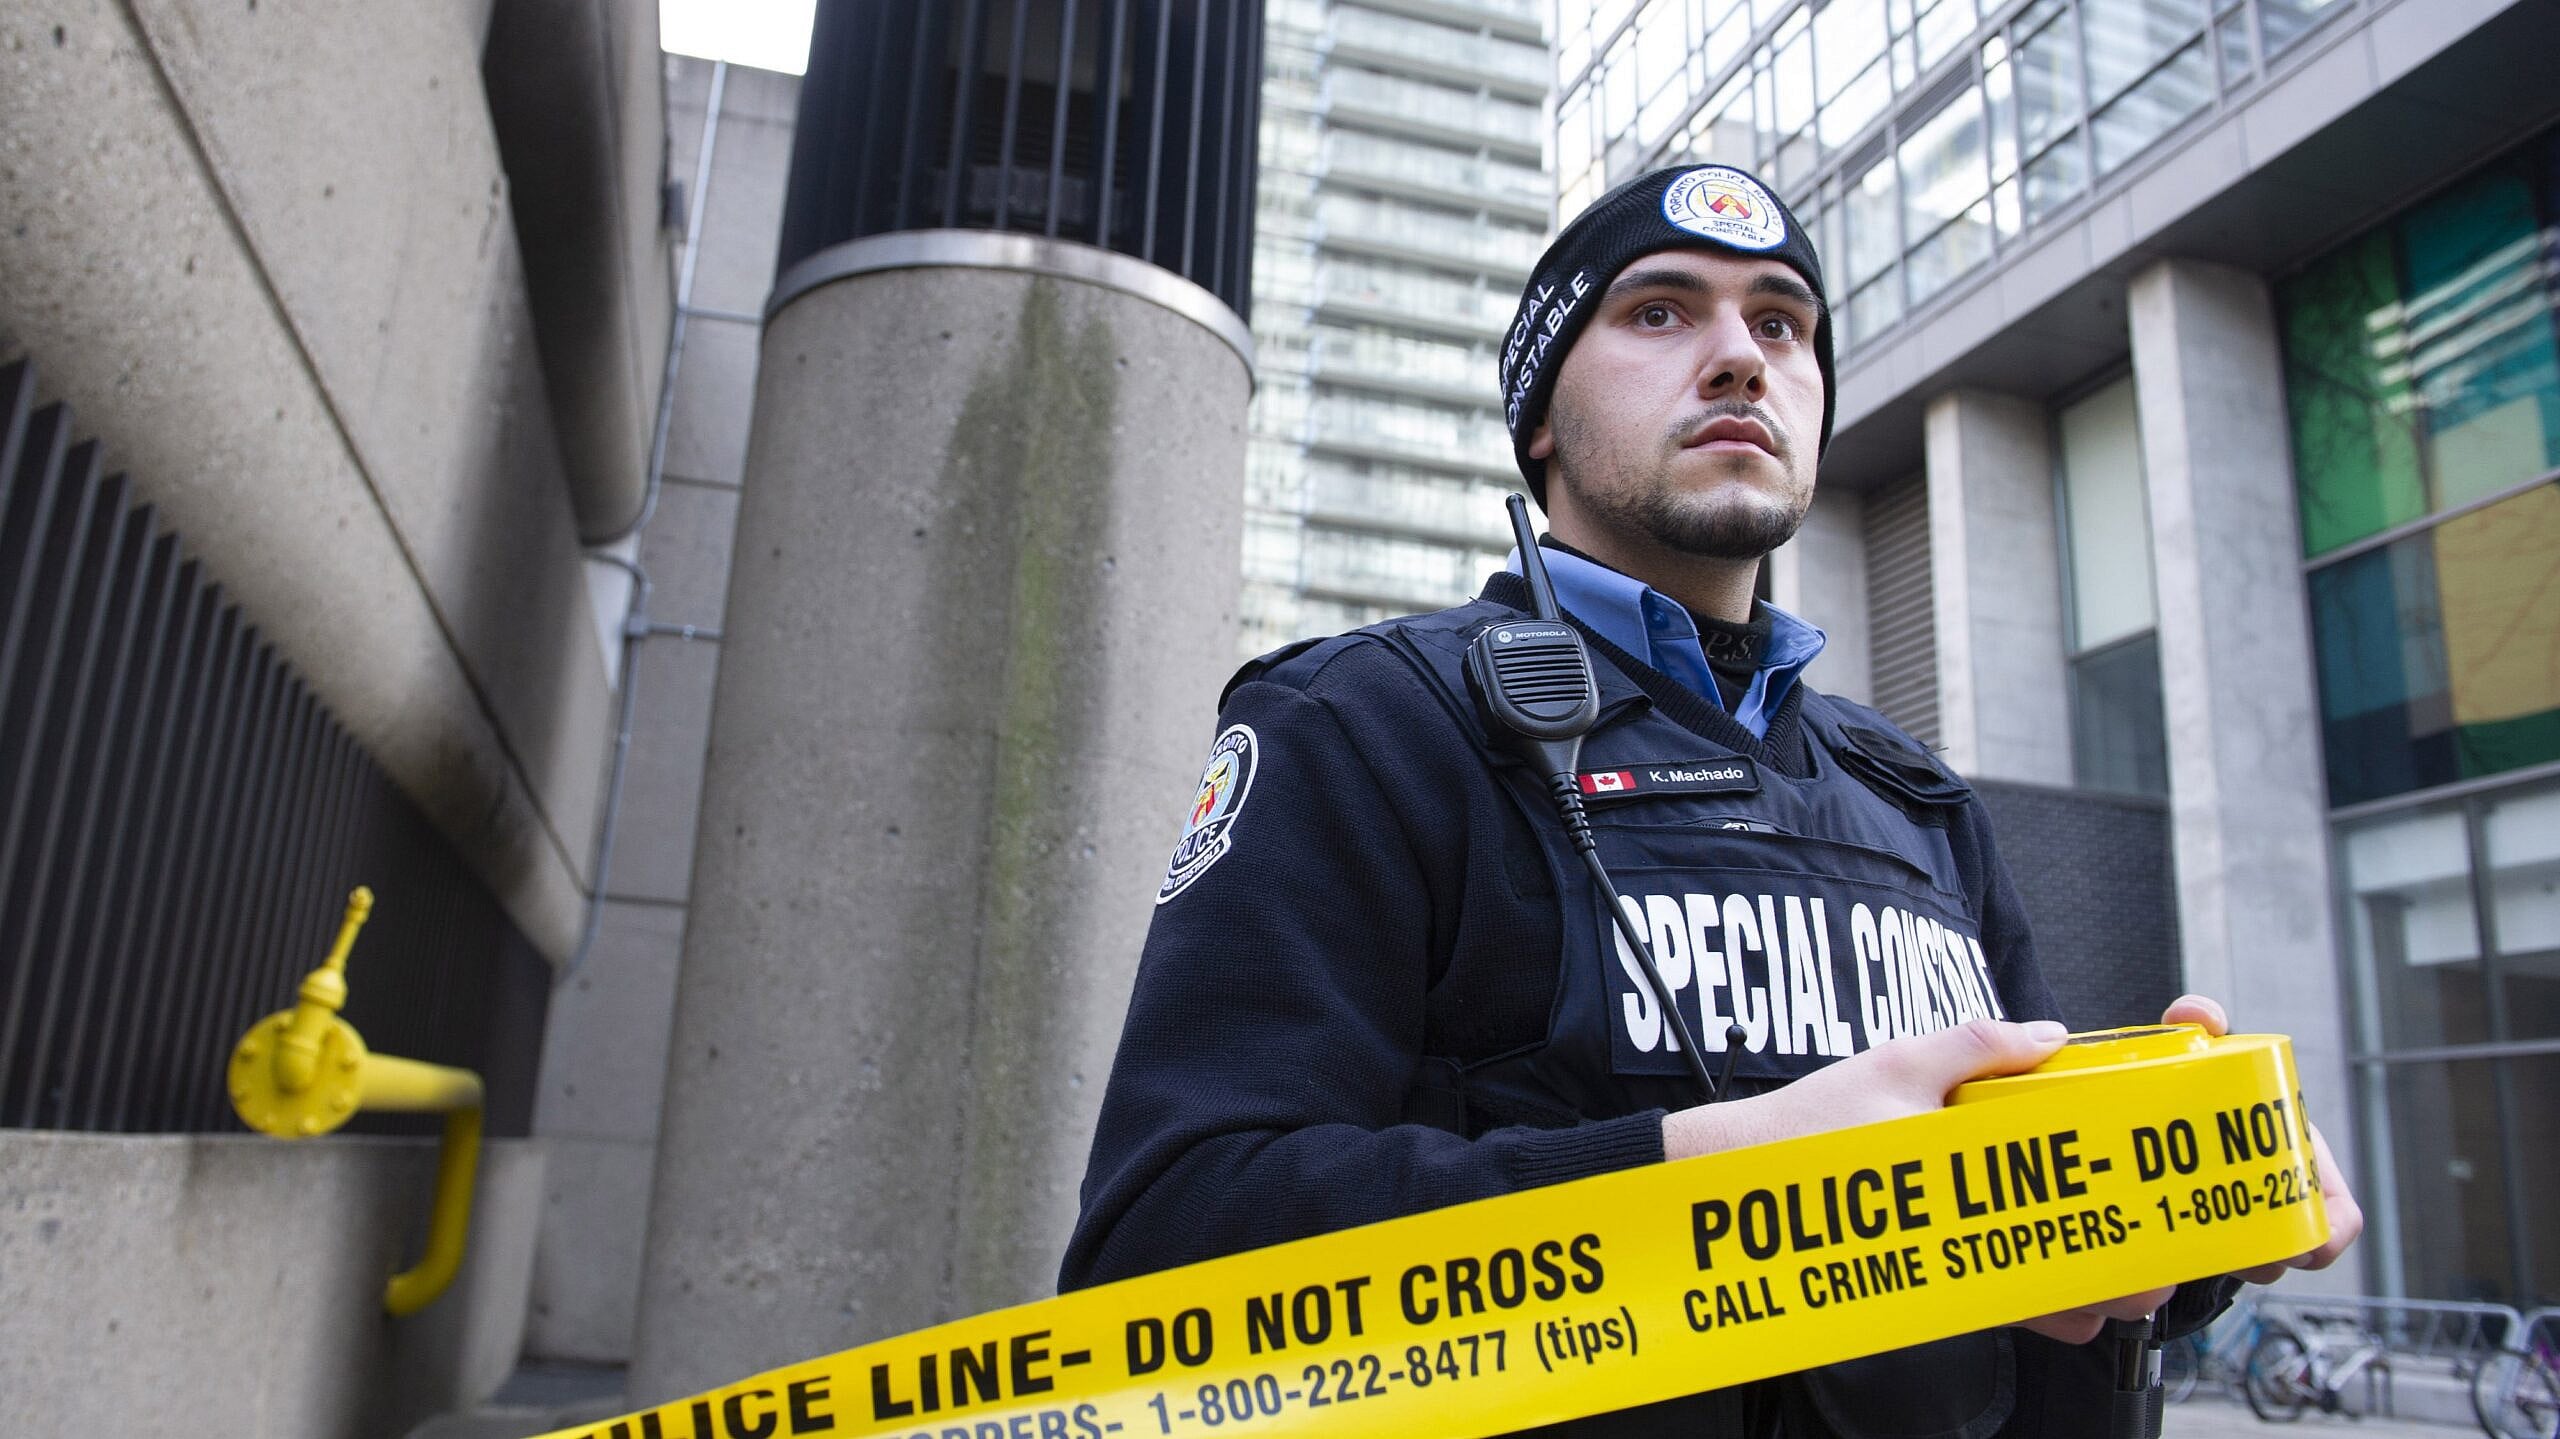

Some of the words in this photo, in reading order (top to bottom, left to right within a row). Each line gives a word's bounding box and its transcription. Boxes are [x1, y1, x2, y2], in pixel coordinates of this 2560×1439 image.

[1669, 177, 1696, 216] TORONTO
[1699, 171, 1749, 186] POLICE
[1702, 226, 1766, 243] CONSTABLE
[1713, 220, 1757, 234] SPECIAL
[1508, 271, 1590, 430] ONSTABLE
[1649, 771, 1669, 782] K.
[1668, 767, 1744, 782] Machado
[1173, 823, 1218, 866] POLICE
[1613, 894, 1854, 1057] SPECIAL
[1691, 1160, 1931, 1271] POLICE
[1950, 1129, 2111, 1219] LINE-
[2132, 1118, 2200, 1182] DO
[2215, 1099, 2292, 1166] NOT
[1683, 1277, 1785, 1333] CALL
[1800, 1246, 1927, 1309] CRIME
[1942, 1204, 2140, 1279] STOPPERS-
[578, 1376, 835, 1439] LICE
[871, 1329, 1091, 1422] LINE-
[1126, 1309, 1213, 1376] DO
[1246, 1276, 1372, 1354] NOT
[1399, 1232, 1604, 1325] CROSS
[1148, 1329, 1508, 1436] 1-800-222-8477
[1535, 1305, 1639, 1372] (tips)
